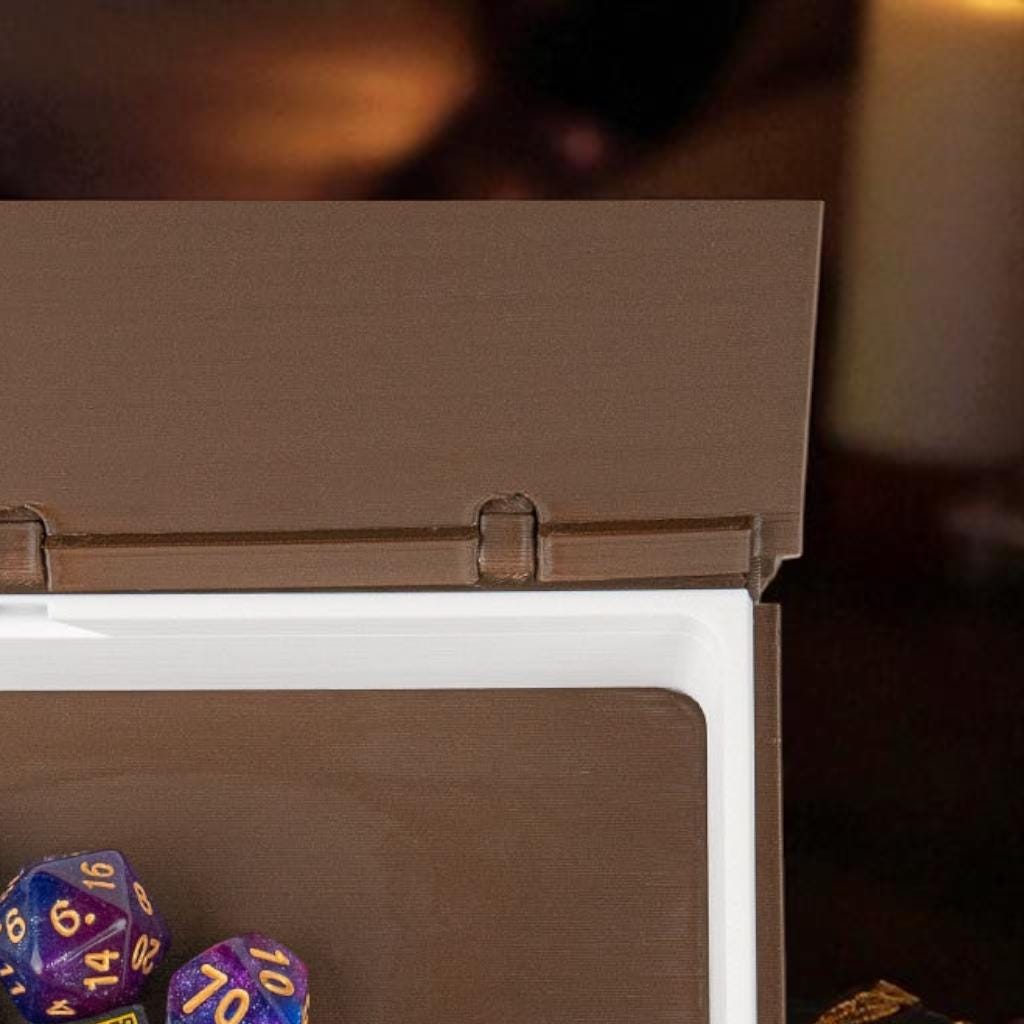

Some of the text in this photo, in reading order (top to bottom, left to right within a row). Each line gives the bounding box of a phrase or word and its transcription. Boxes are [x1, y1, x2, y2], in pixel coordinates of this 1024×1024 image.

[80, 861, 117, 890] 16
[83, 949, 121, 991] 14
[249, 947, 295, 997] 10
